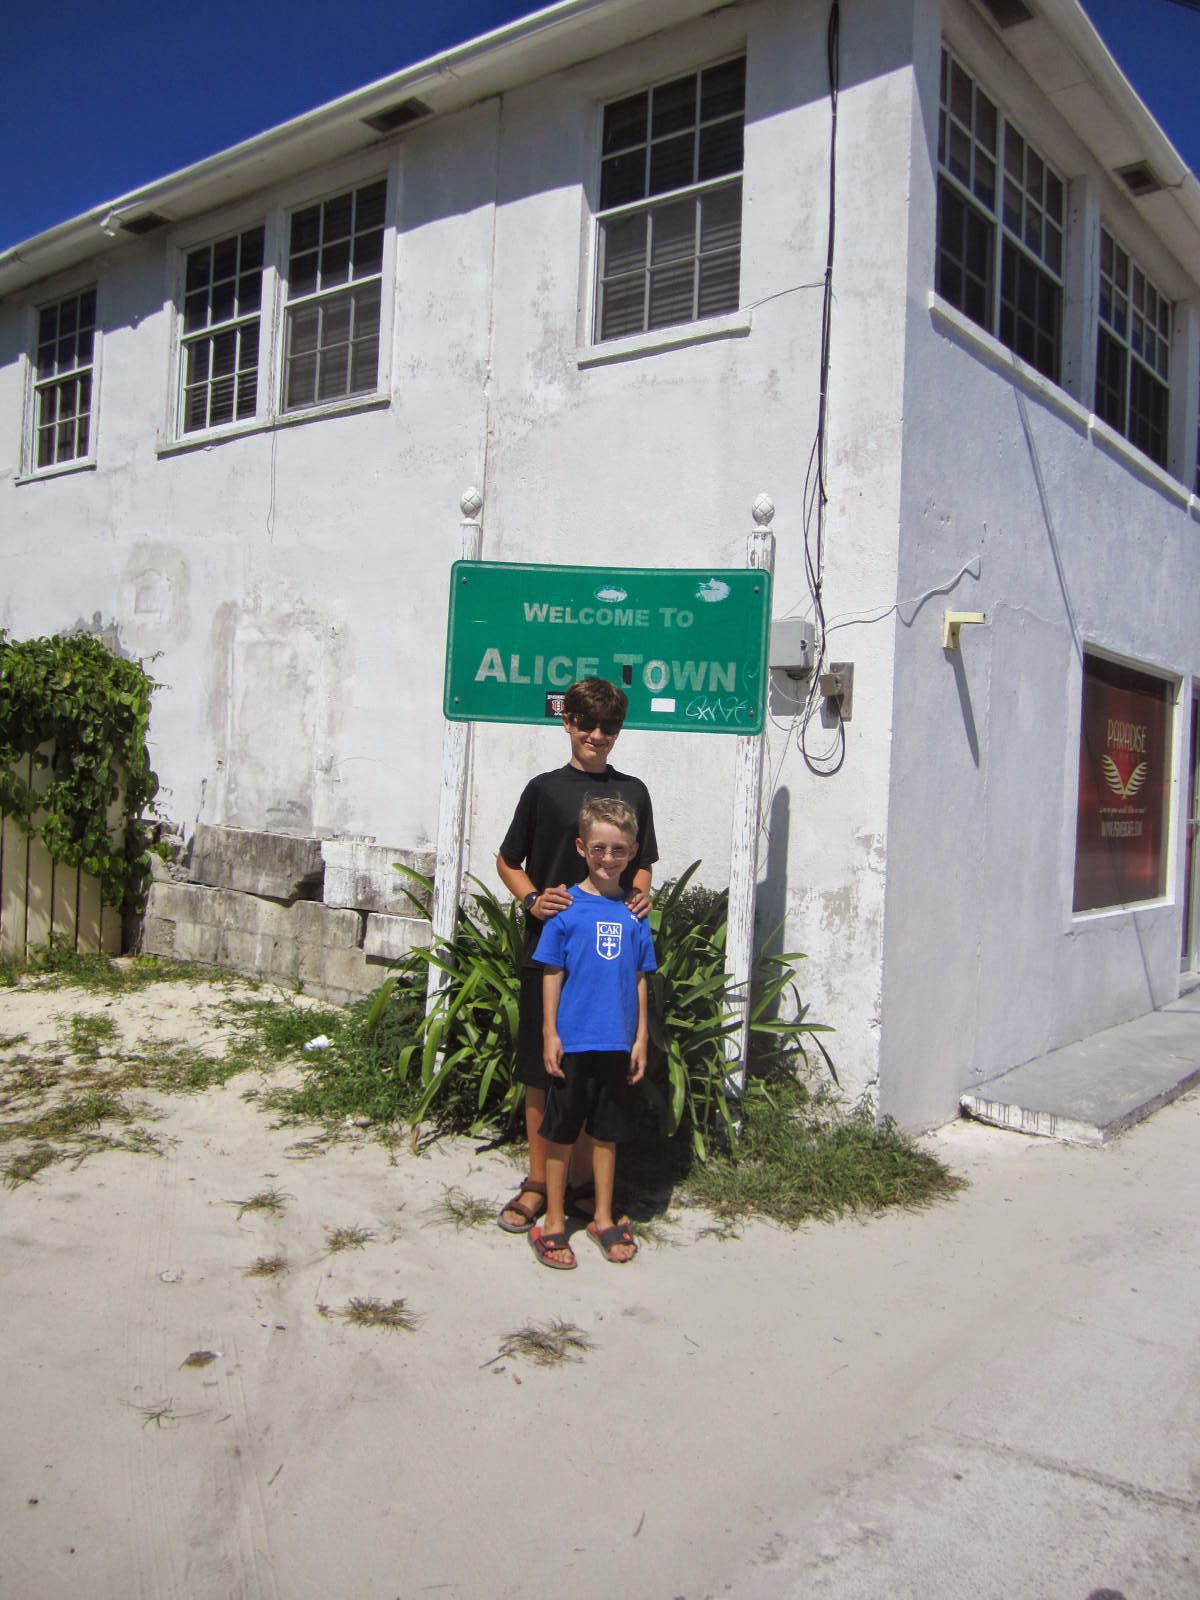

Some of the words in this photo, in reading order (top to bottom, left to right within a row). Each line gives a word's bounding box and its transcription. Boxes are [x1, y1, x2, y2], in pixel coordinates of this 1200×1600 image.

[524, 602, 649, 627] WELCOME
[660, 607, 694, 627] TO
[475, 648, 599, 685] ALICE
[613, 653, 736, 692] TOWN
[1107, 719, 1147, 752] PARADISE
[599, 924, 620, 935] CAK
